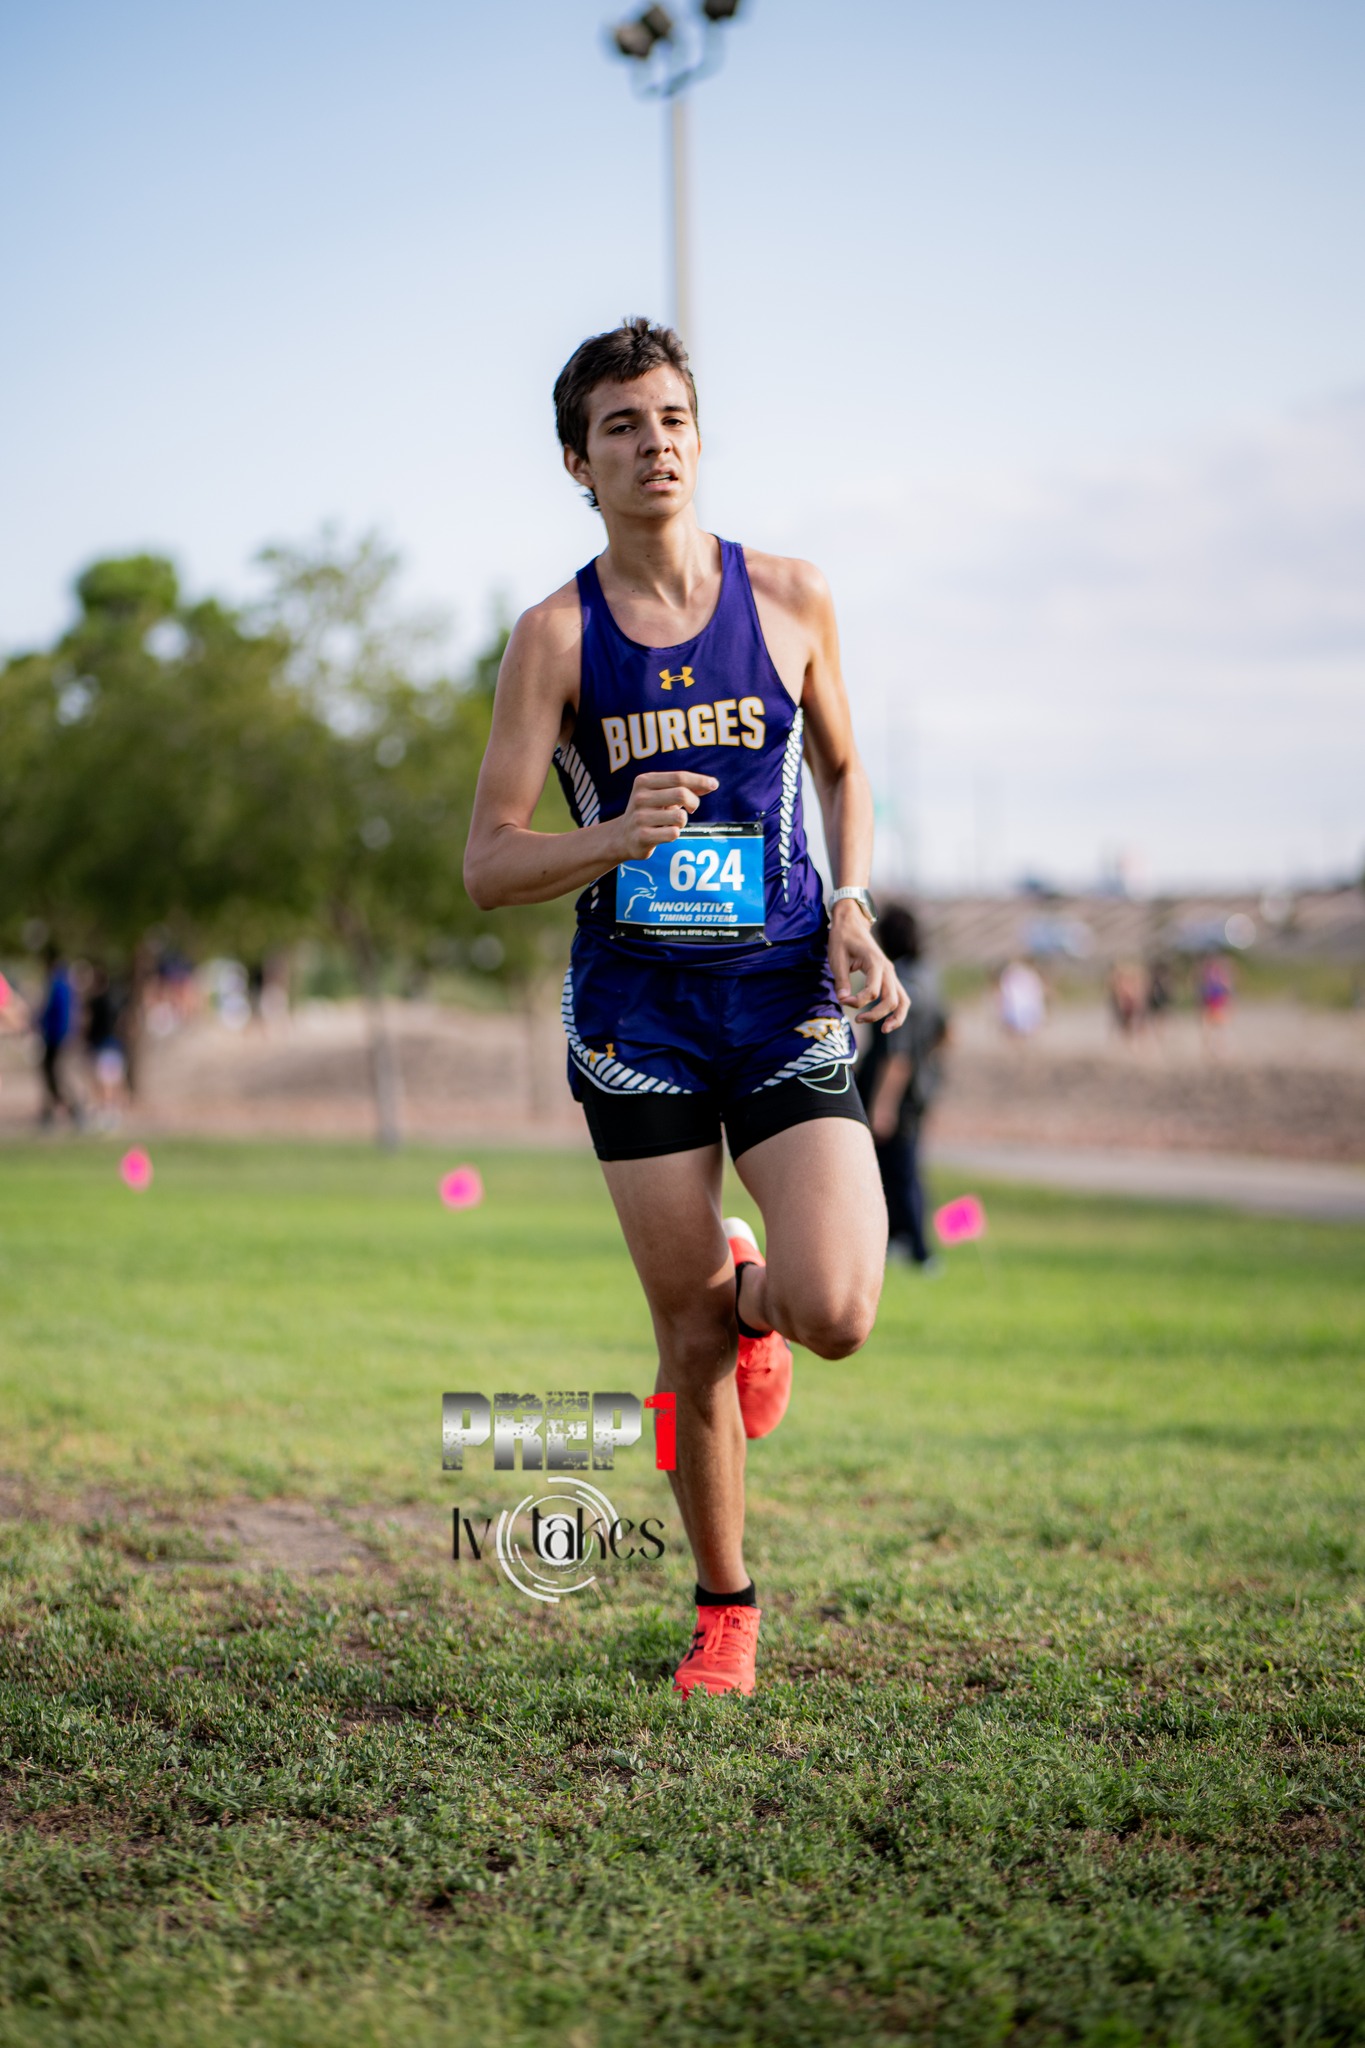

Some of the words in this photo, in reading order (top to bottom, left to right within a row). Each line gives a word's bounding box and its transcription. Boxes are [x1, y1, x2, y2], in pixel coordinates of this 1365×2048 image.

[601, 696, 766, 774] BURGES
[669, 848, 745, 892] 624
[648, 902, 734, 913] INNOVATIVE
[659, 914, 693, 922] TIMING
[694, 914, 738, 923] SYSTEMS
[703, 929, 717, 937] Chip
[718, 930, 739, 938] Timing
